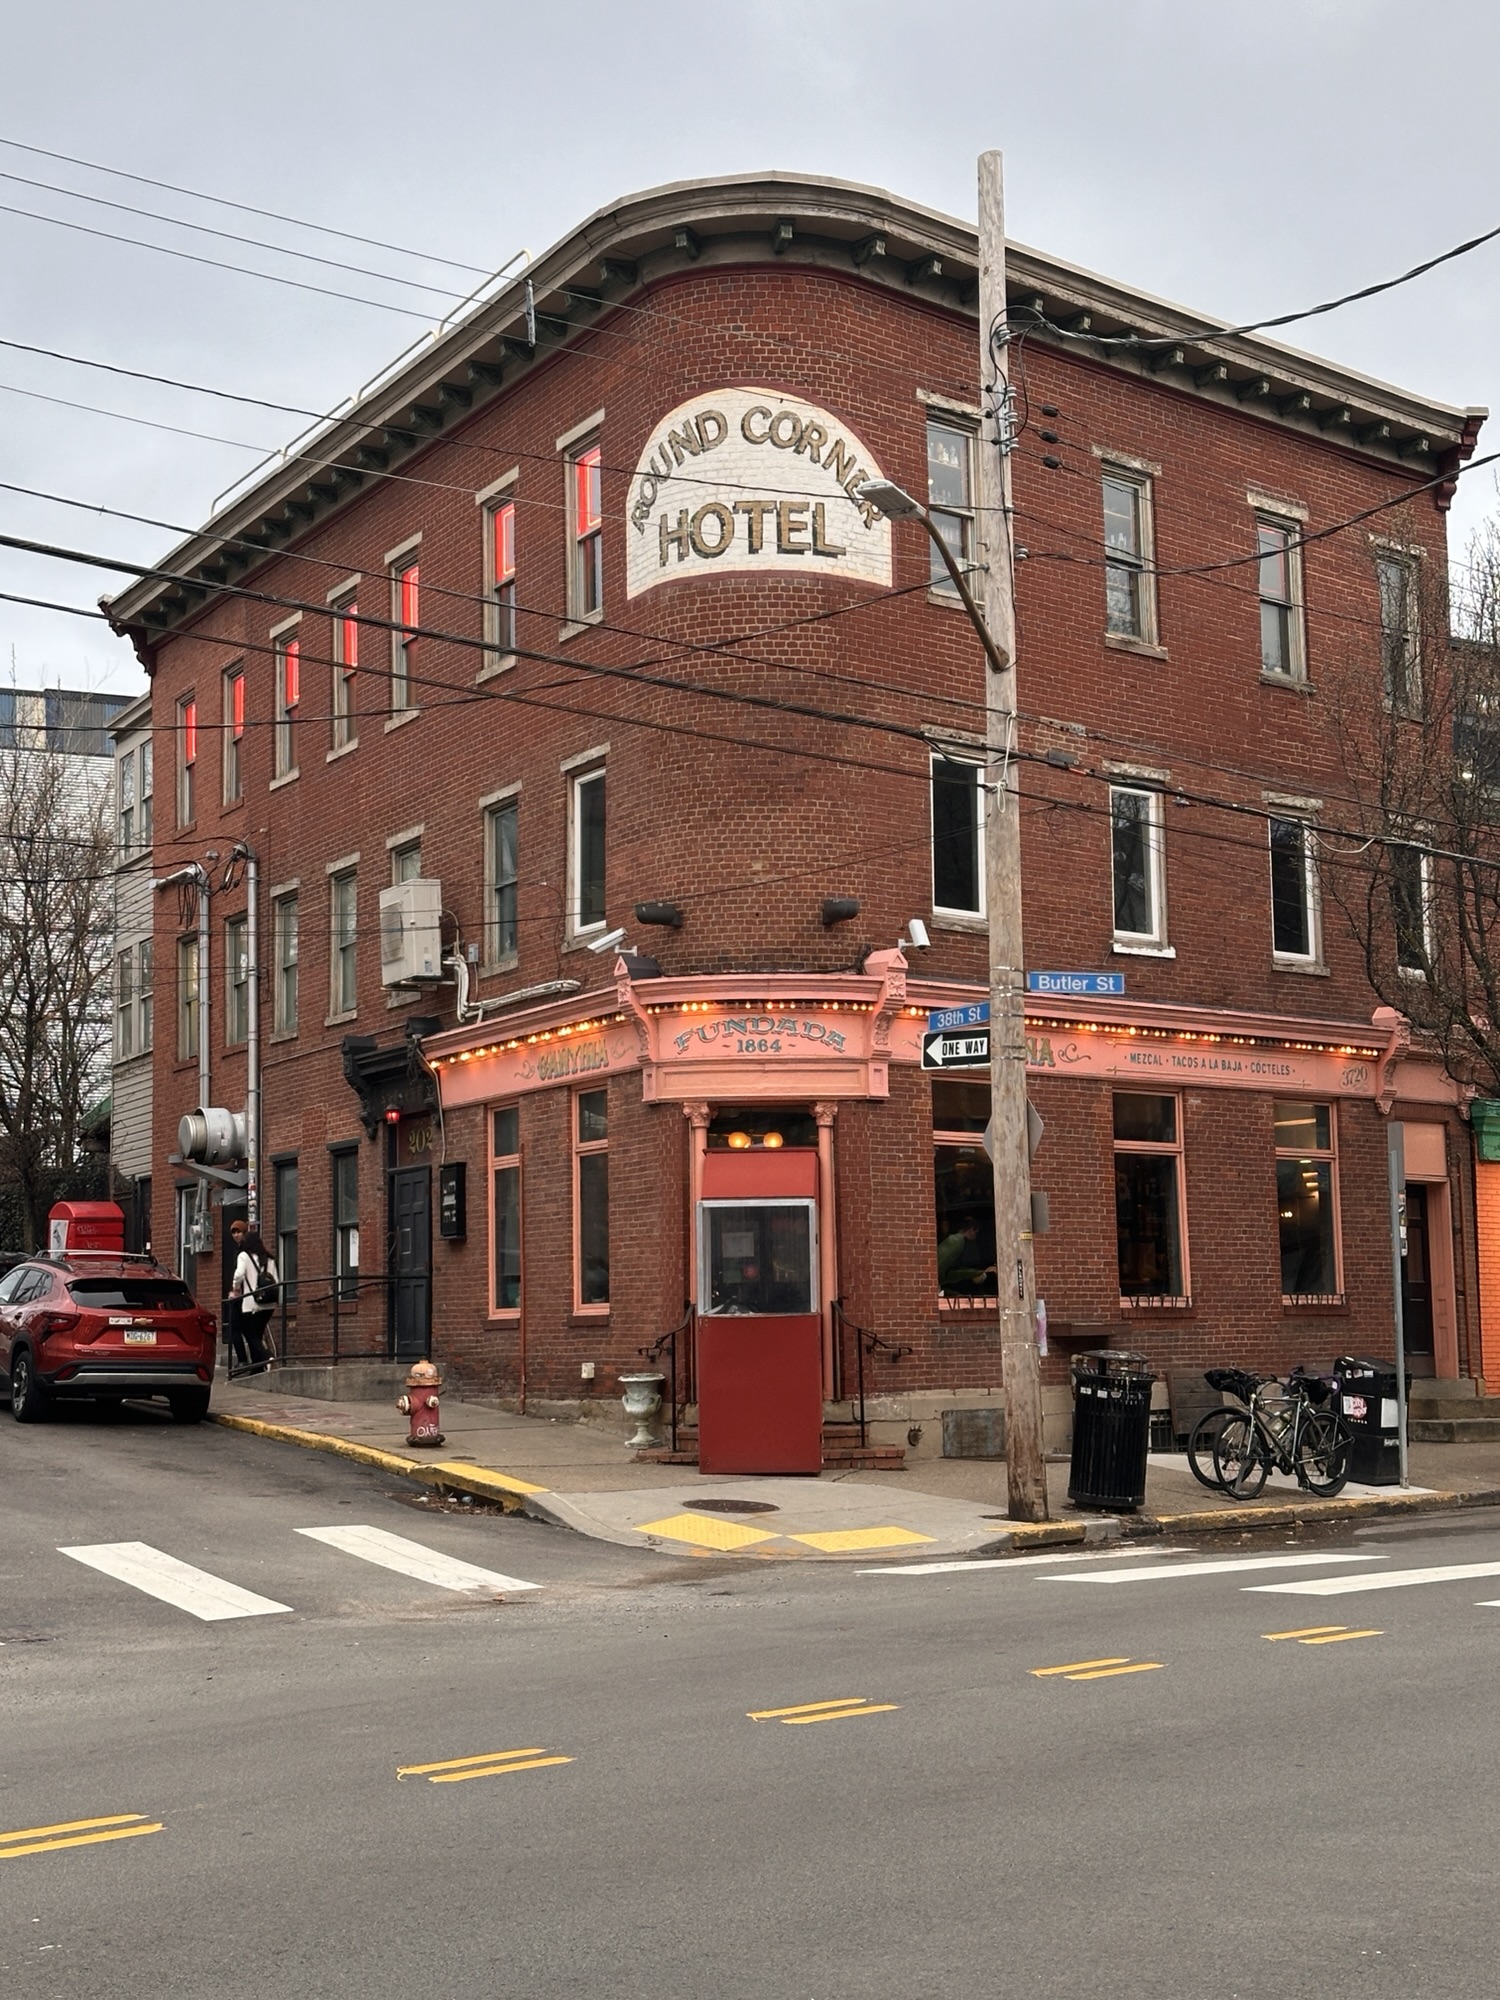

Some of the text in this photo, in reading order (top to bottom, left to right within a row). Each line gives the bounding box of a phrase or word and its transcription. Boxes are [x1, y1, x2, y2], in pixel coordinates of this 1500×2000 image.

[631, 406, 883, 535] ROUND CORNER
[659, 500, 846, 567] HOTEL
[1038, 976, 1115, 991] Butler St
[937, 1007, 981, 1028] 38th St
[673, 1015, 847, 1055] FUNDADA
[737, 1038, 782, 1054] 1864
[942, 1039, 985, 1057] ONE WAY
[1130, 1052, 1290, 1076] MEZCAL TACOS A LA BAJA CÓCTELES
[1342, 1066, 1368, 1086] 3720
[409, 1127, 433, 1154] 202
